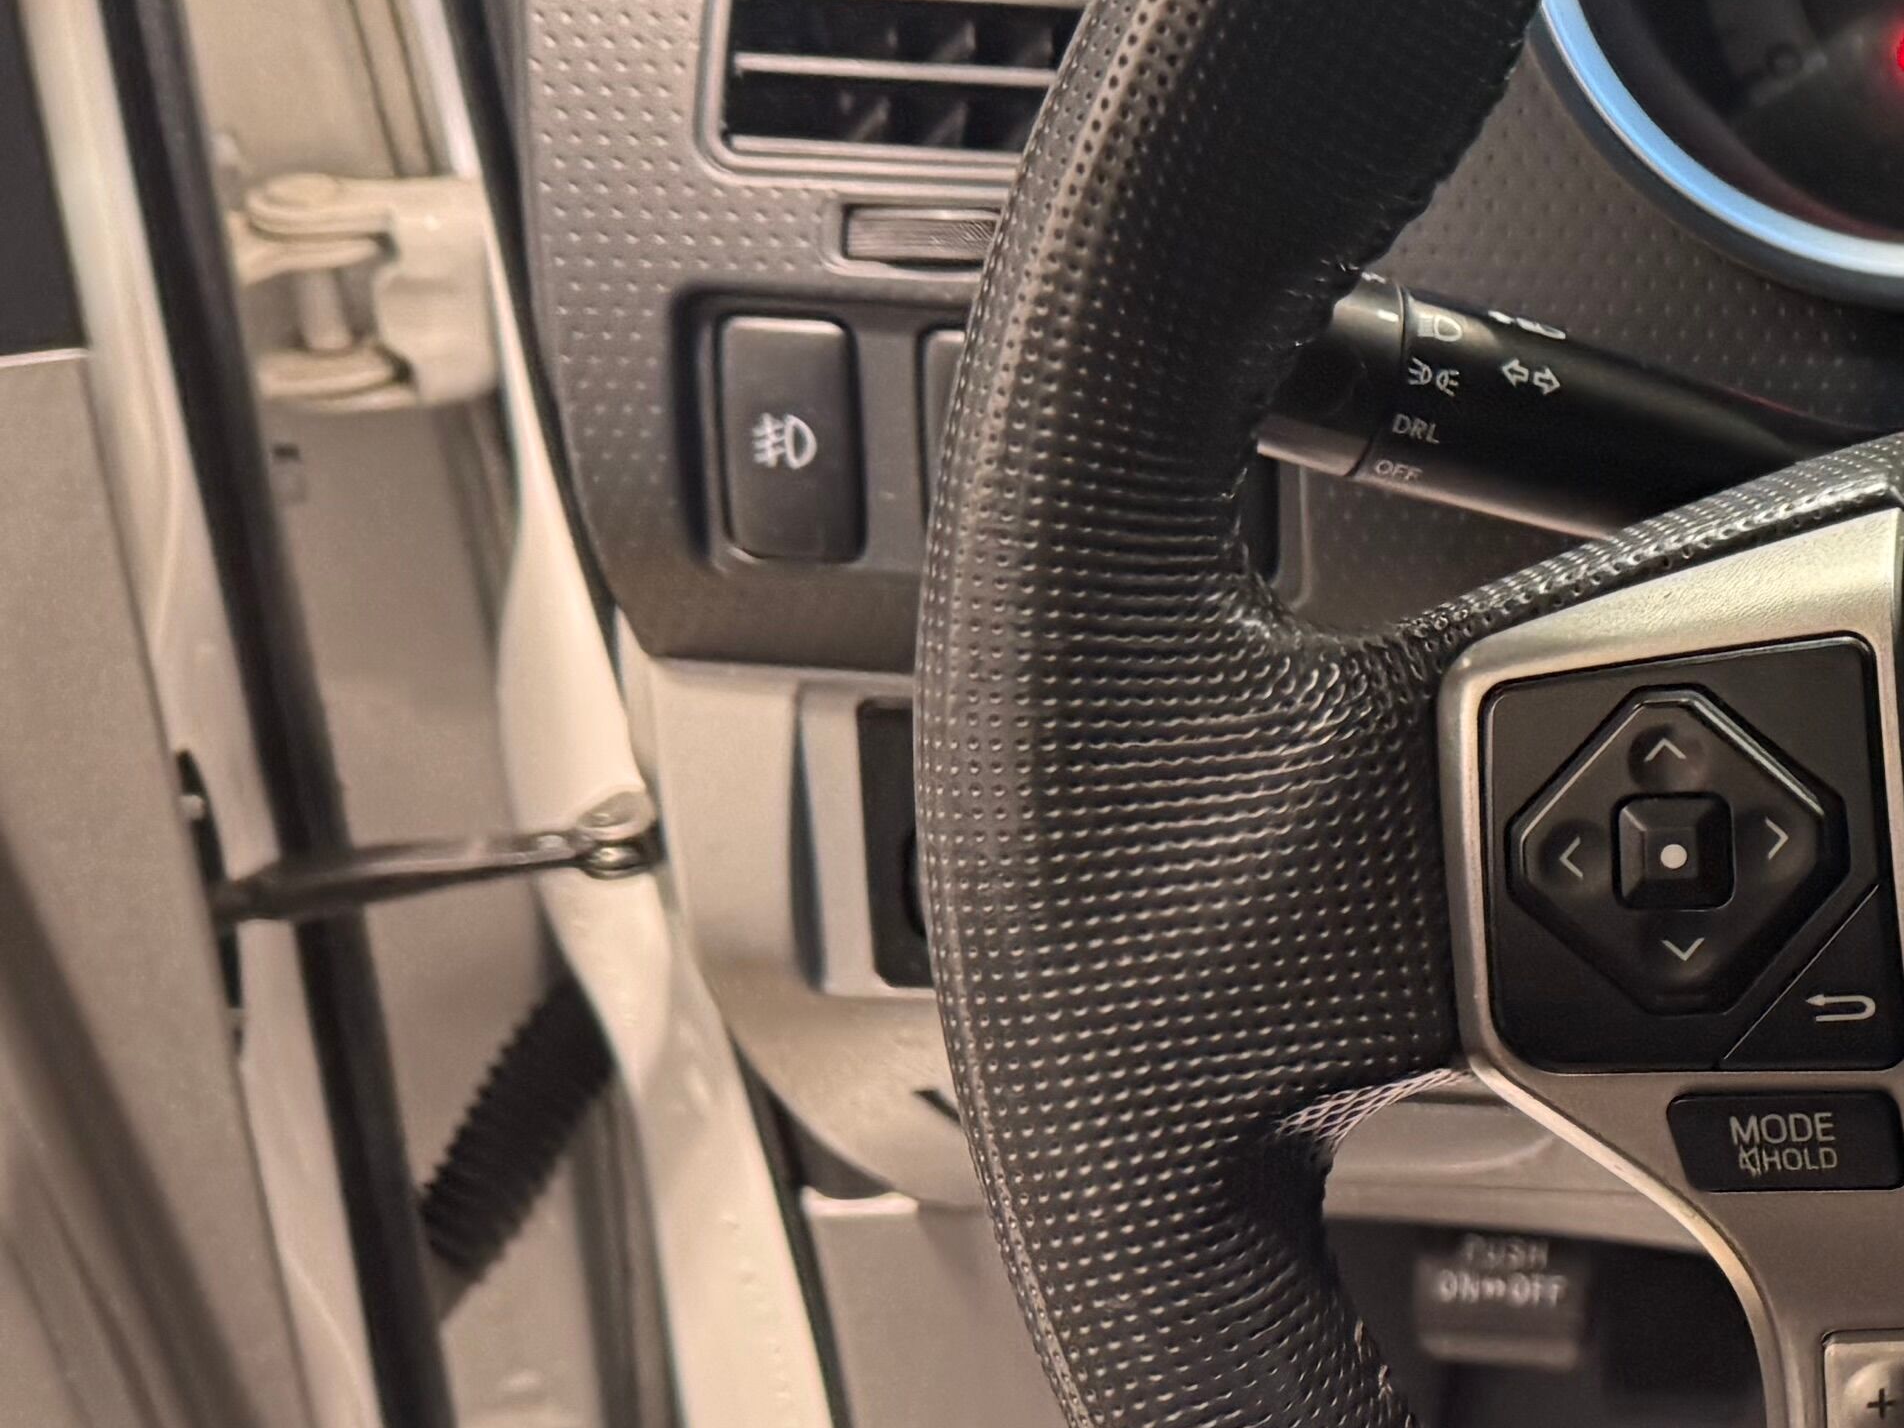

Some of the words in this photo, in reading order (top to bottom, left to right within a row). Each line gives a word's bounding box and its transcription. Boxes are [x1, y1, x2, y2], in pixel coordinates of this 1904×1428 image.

[1391, 414, 1440, 445] DRL
[1374, 458, 1422, 482] OFF
[1729, 1112, 1836, 1146] MODE
[1763, 1147, 1838, 1172] HOLD
